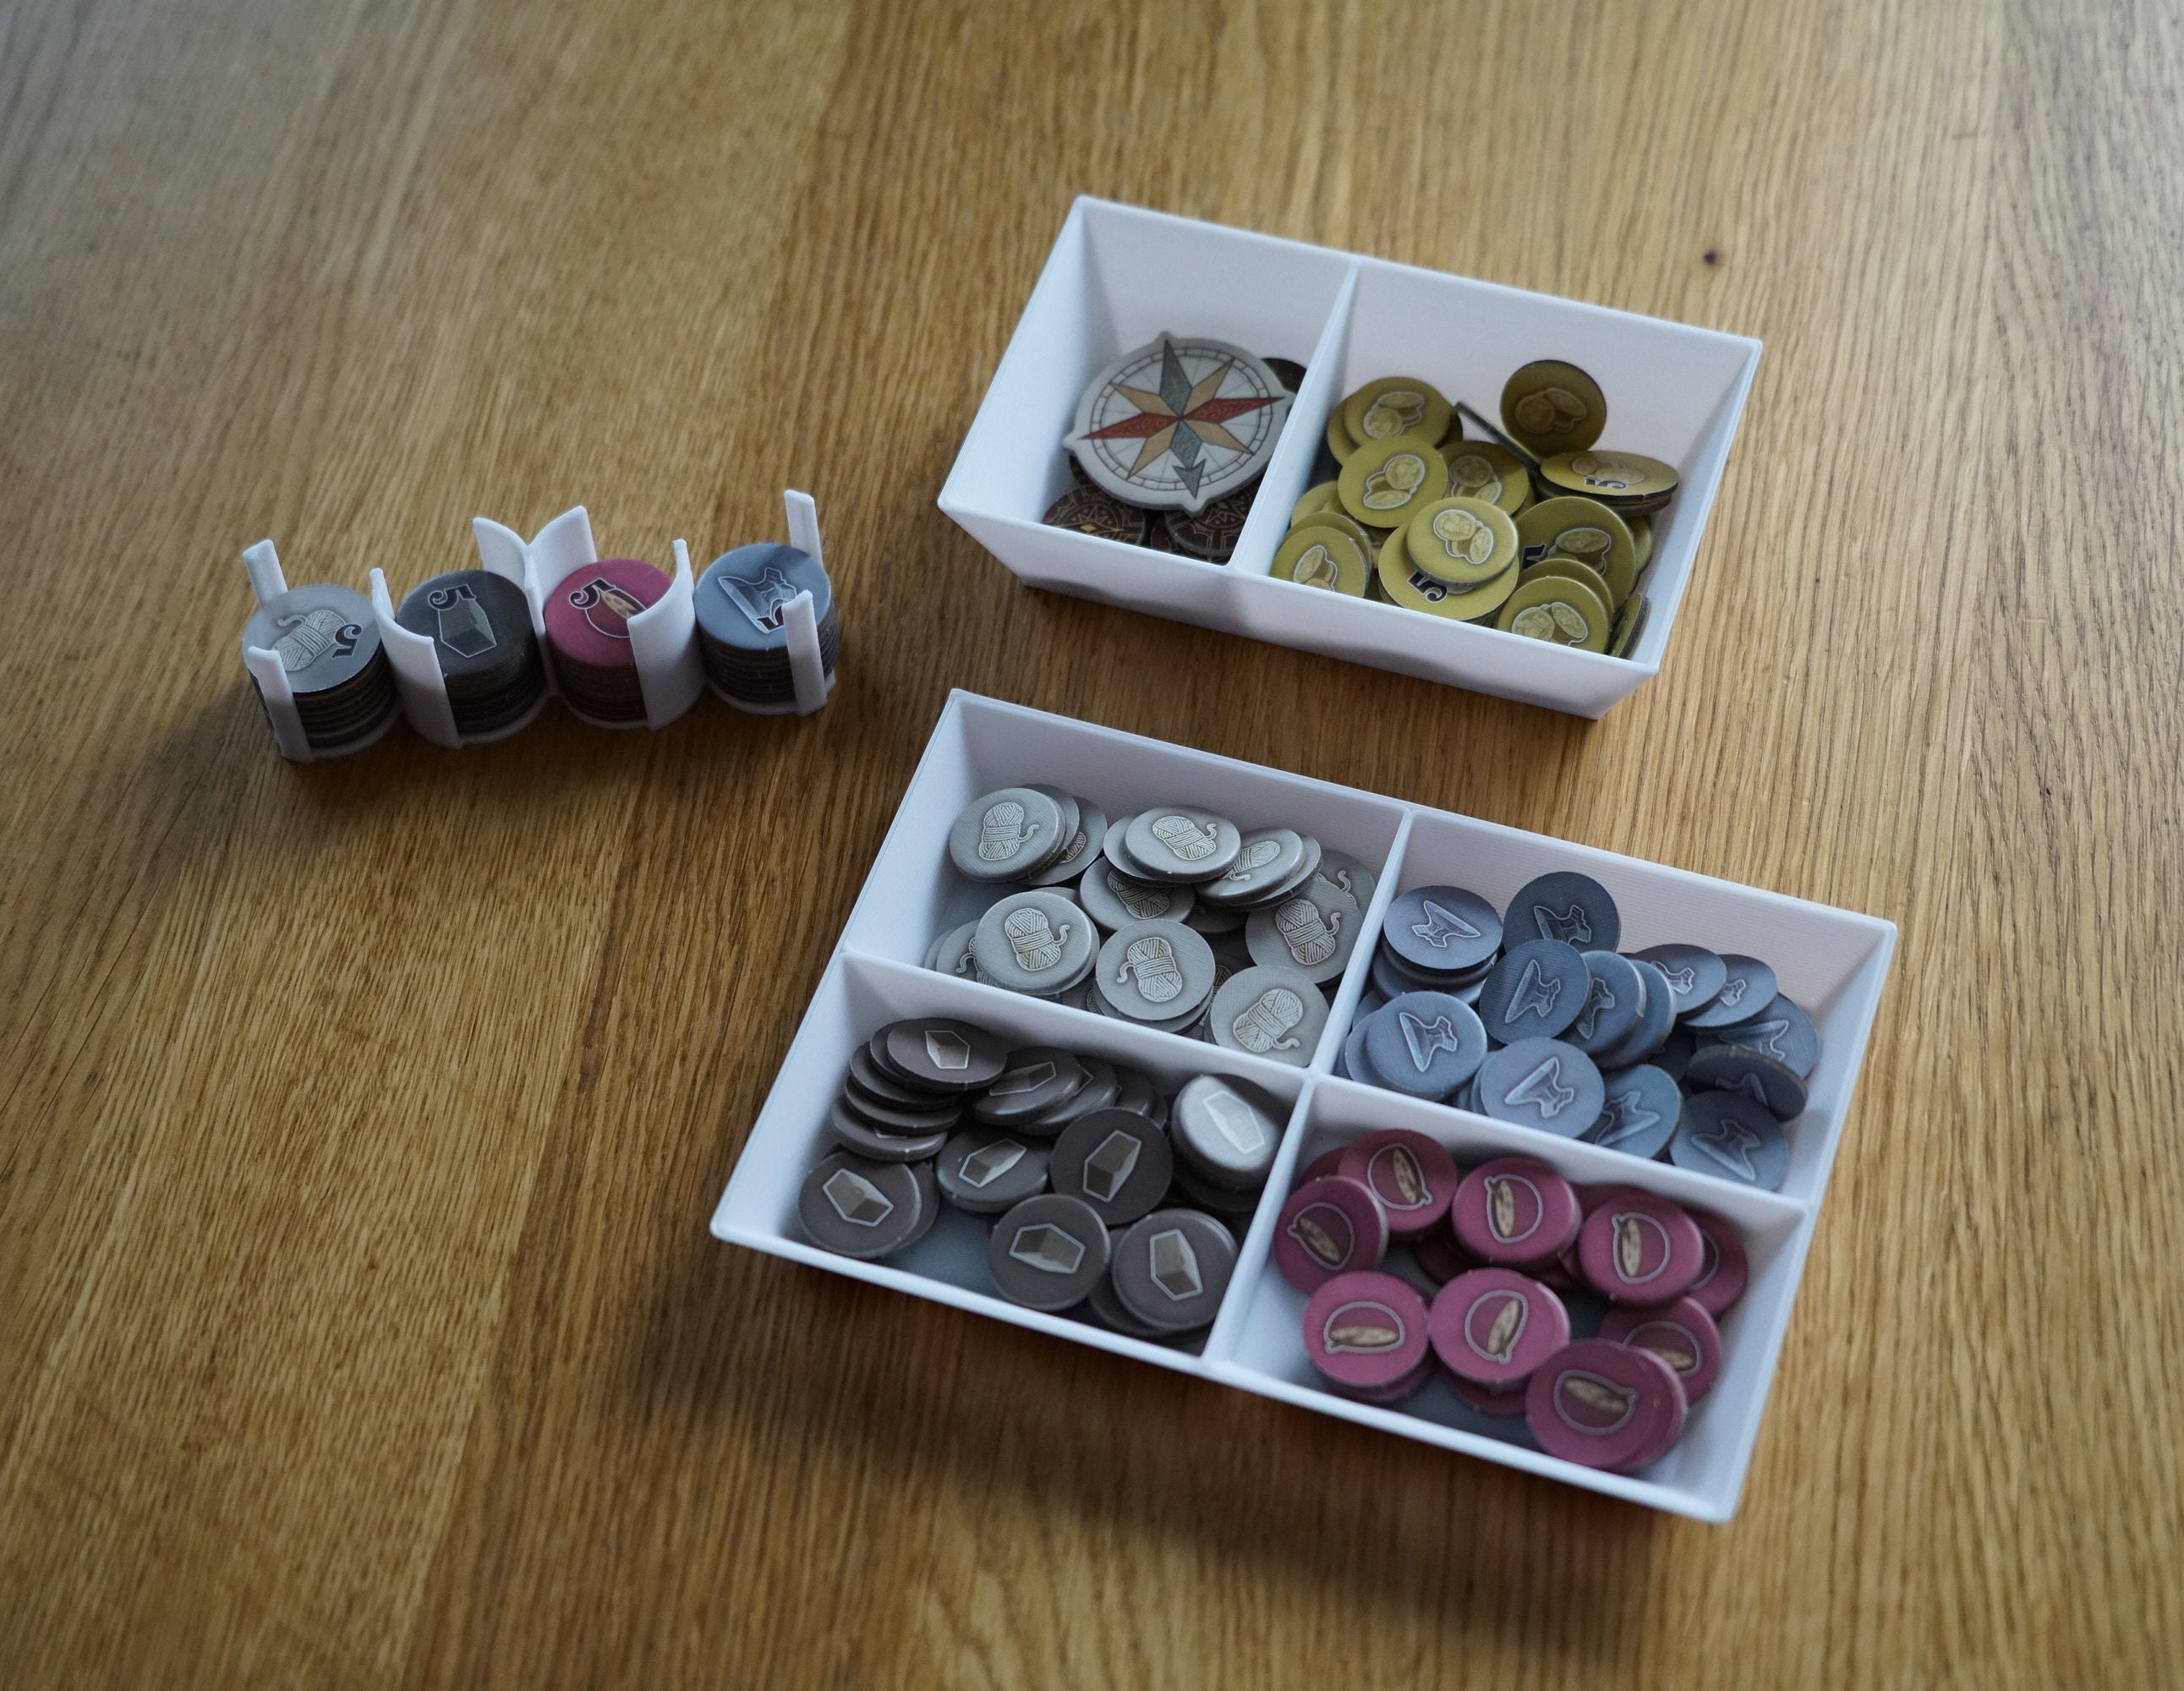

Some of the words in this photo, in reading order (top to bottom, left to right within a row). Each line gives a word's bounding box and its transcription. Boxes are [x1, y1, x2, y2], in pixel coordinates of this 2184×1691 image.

[1584, 476, 1627, 489] 5
[428, 583, 476, 610] 5
[569, 577, 616, 609] 5
[1407, 569, 1448, 602] 5
[331, 623, 363, 658] 5
